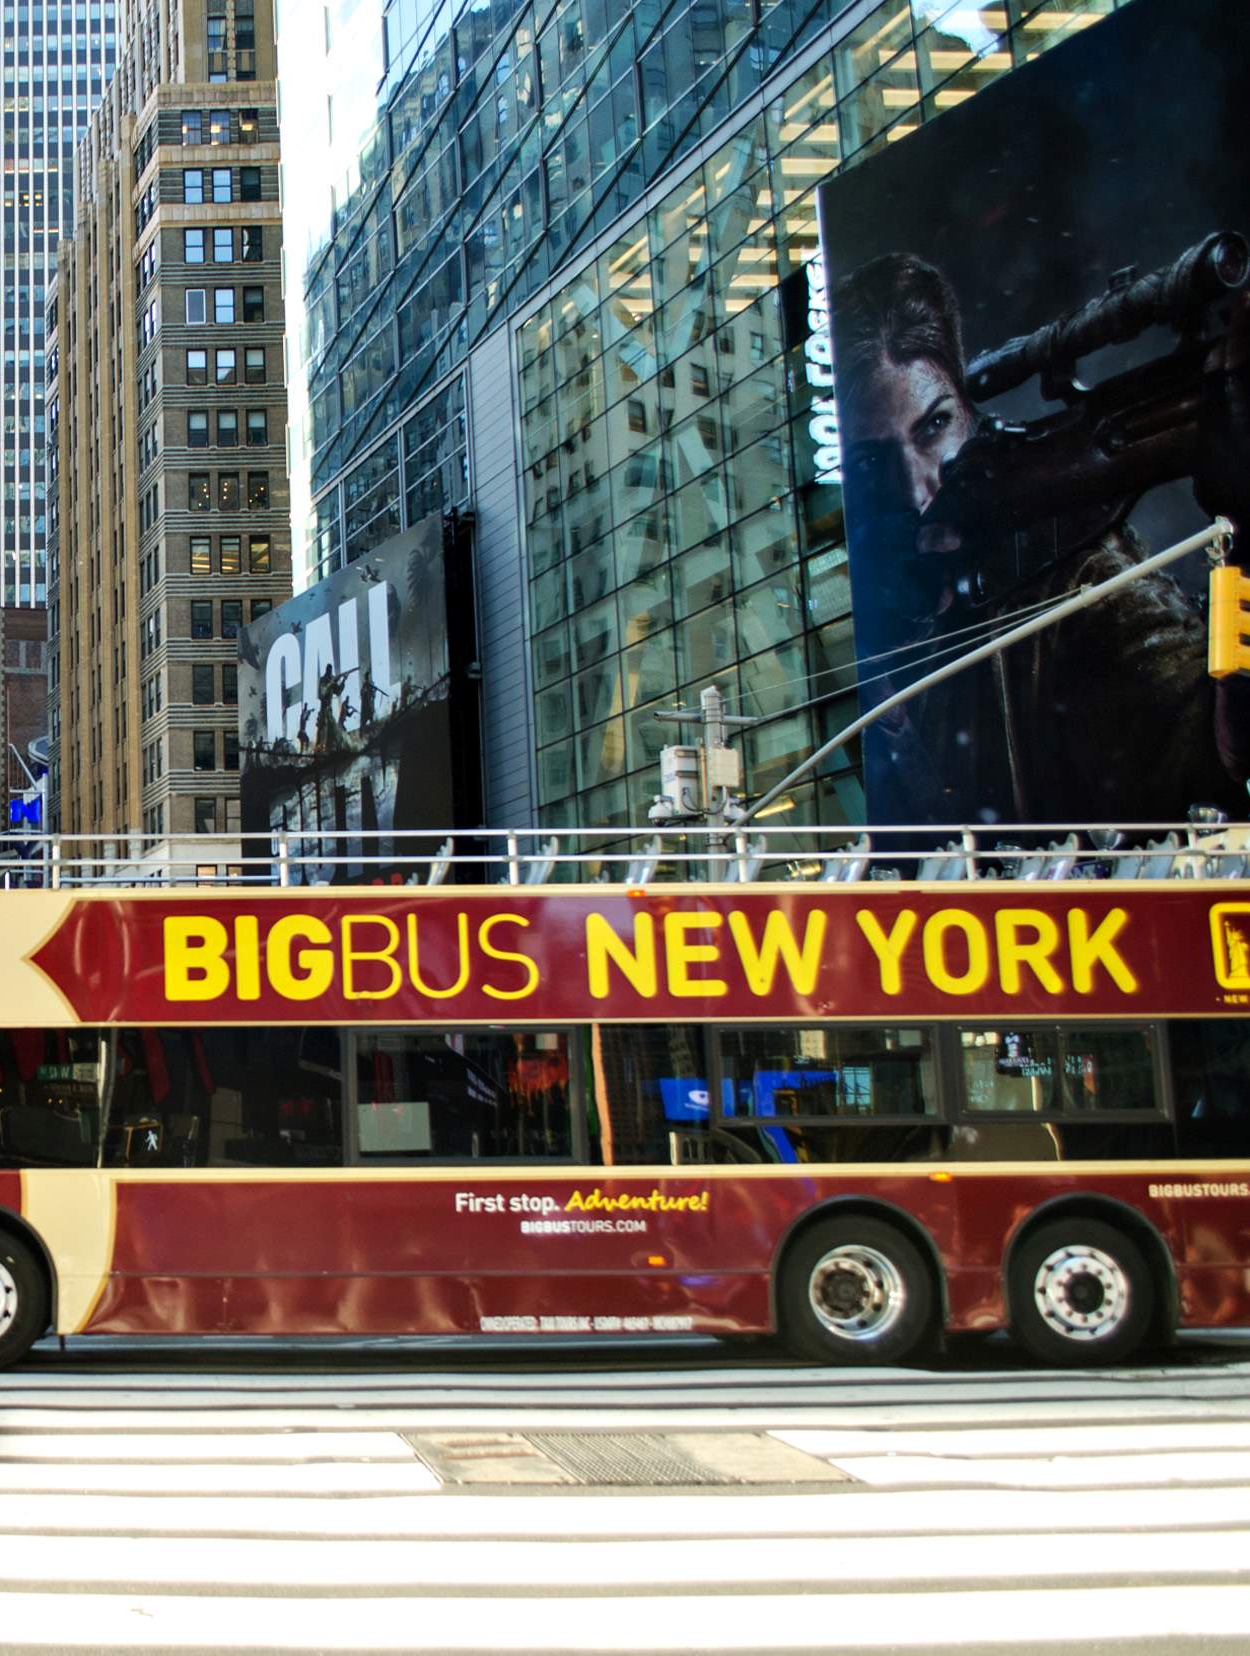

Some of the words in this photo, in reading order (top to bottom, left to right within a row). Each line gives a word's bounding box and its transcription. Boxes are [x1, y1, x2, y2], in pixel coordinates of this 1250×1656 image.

[266, 580, 401, 752] CALL
[585, 908, 827, 999] NEW
[855, 908, 1138, 996] YORK
[455, 1192, 505, 1212] First
[509, 1193, 560, 1215] stop.
[564, 1188, 709, 1212] Adventure!
[520, 1220, 647, 1234] BIGBUSTOURS.COM
